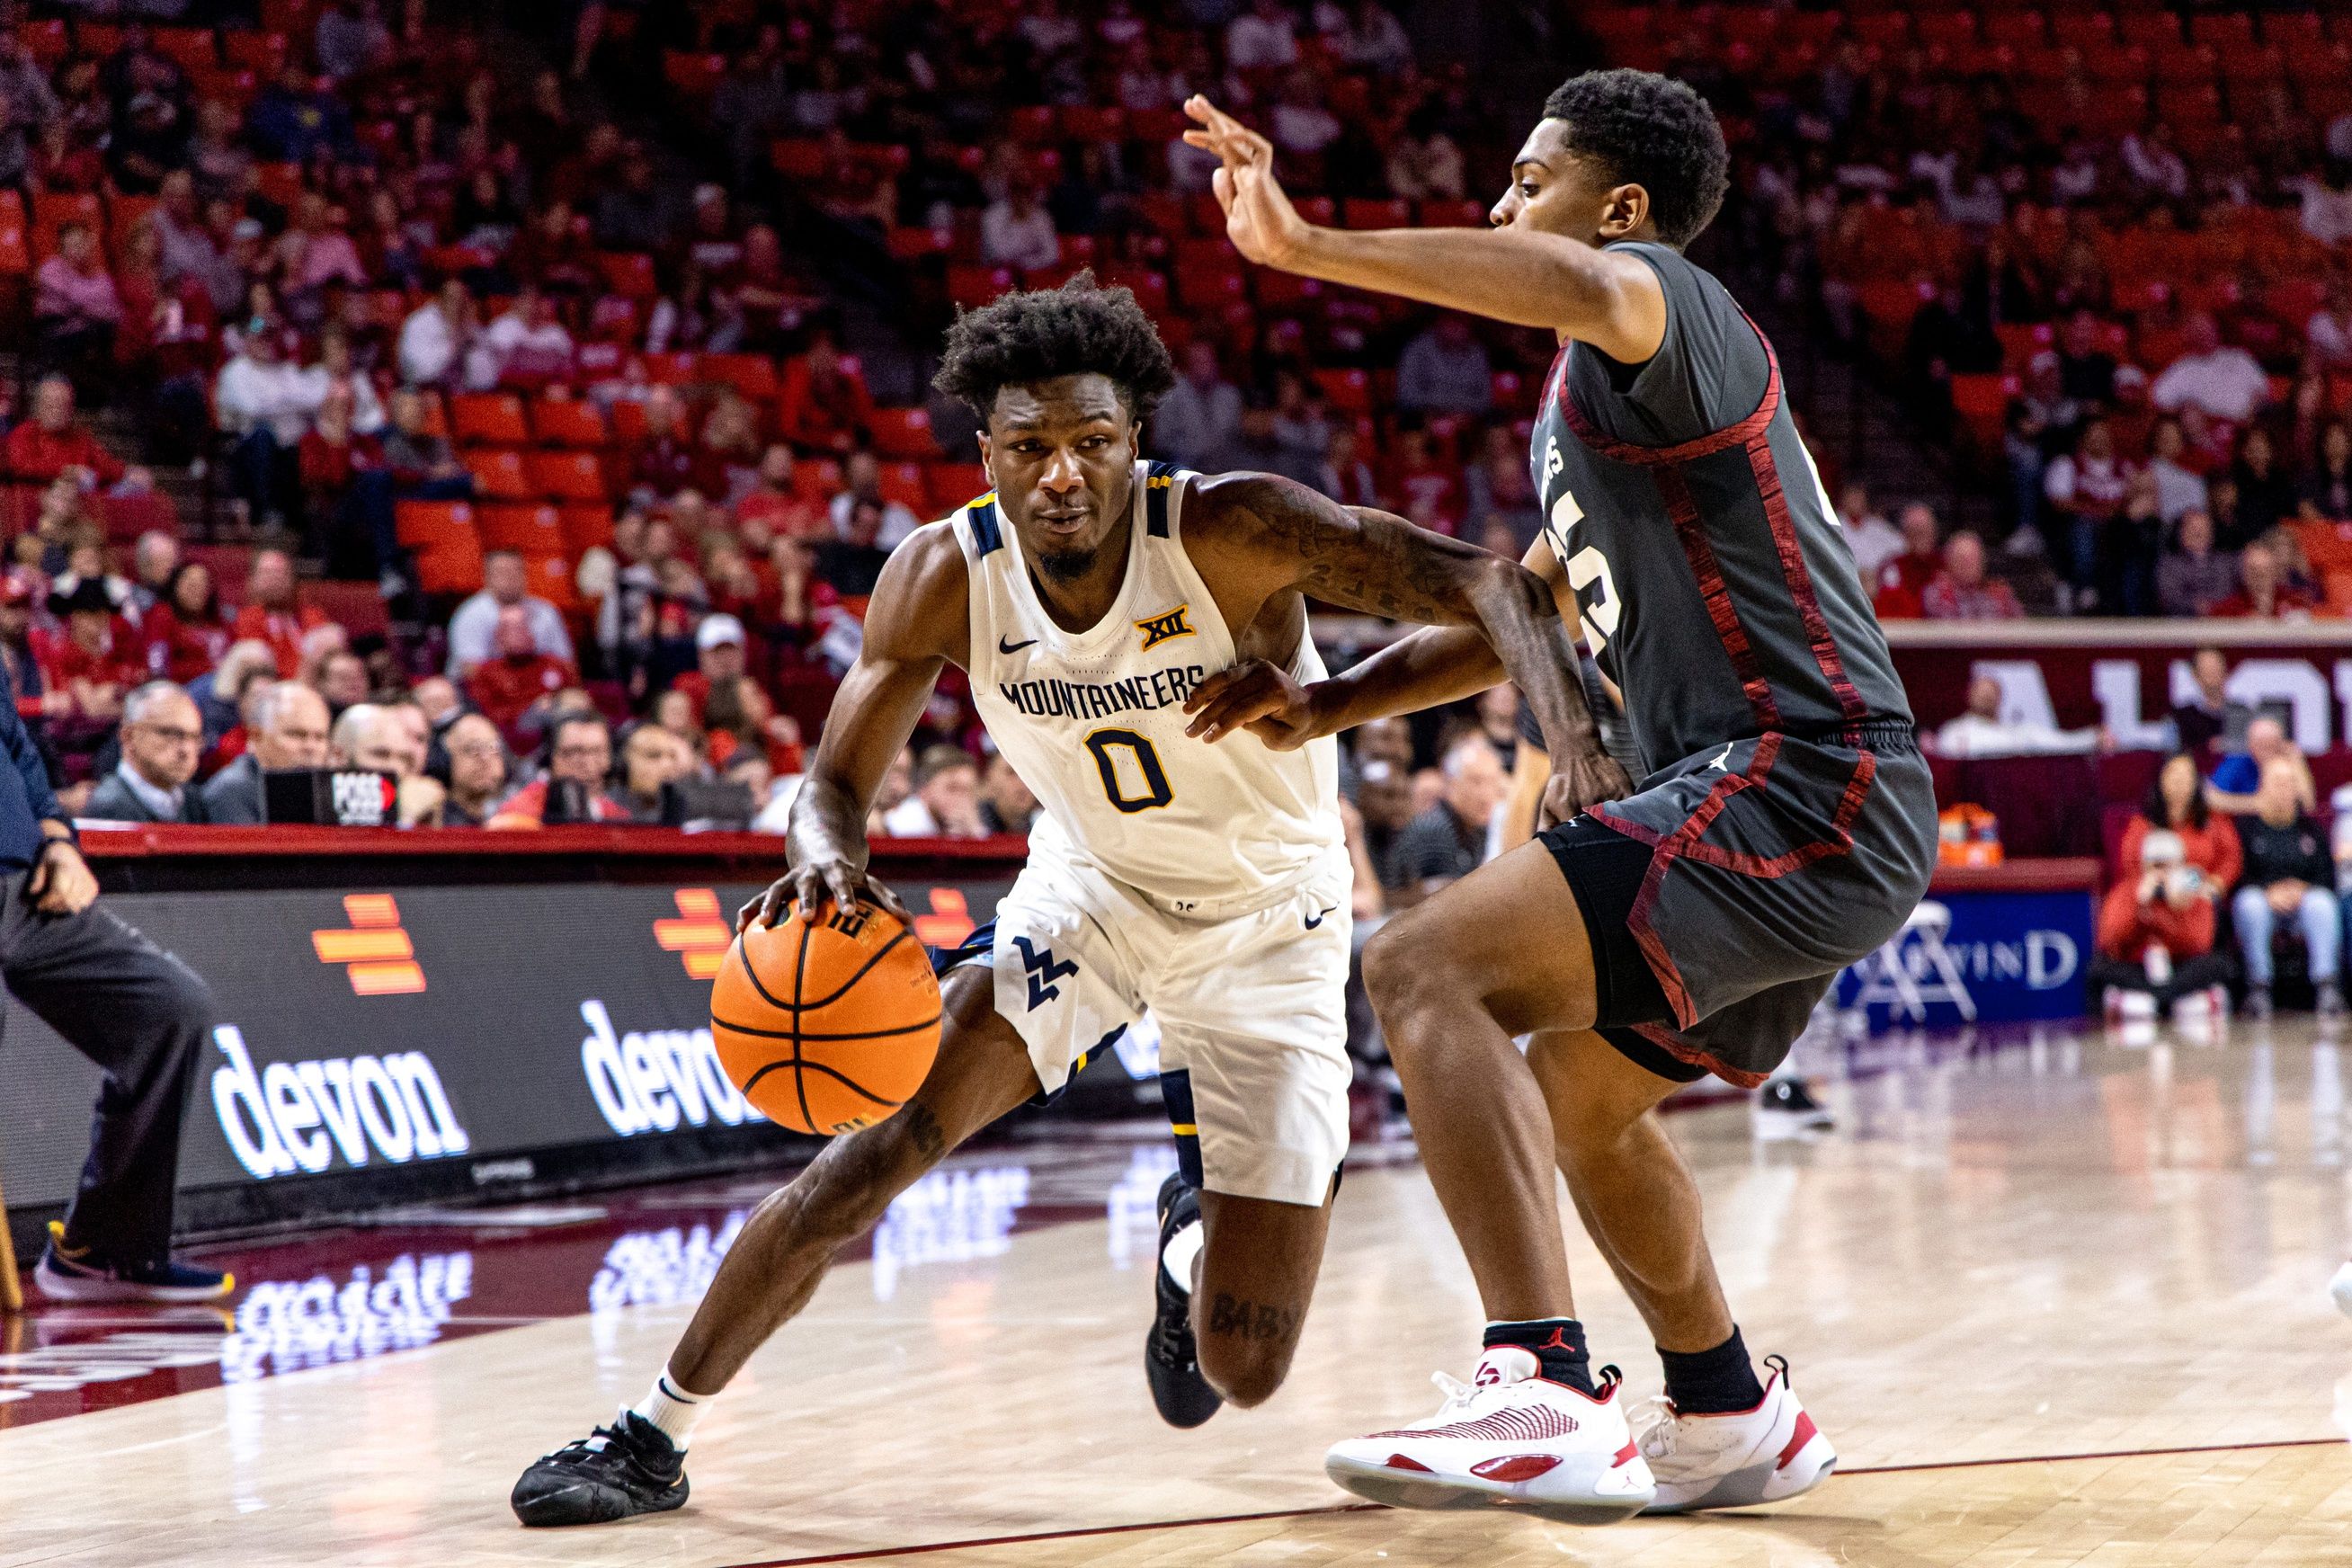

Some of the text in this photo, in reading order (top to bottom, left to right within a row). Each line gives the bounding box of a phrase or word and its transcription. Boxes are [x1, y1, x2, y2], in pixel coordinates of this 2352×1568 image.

[1136, 607, 1193, 648] XII
[999, 664, 1204, 719] MOUNTAINEERS
[1082, 726, 1175, 815] 0
[212, 1025, 468, 1179] devon
[580, 1000, 769, 1136] devo
